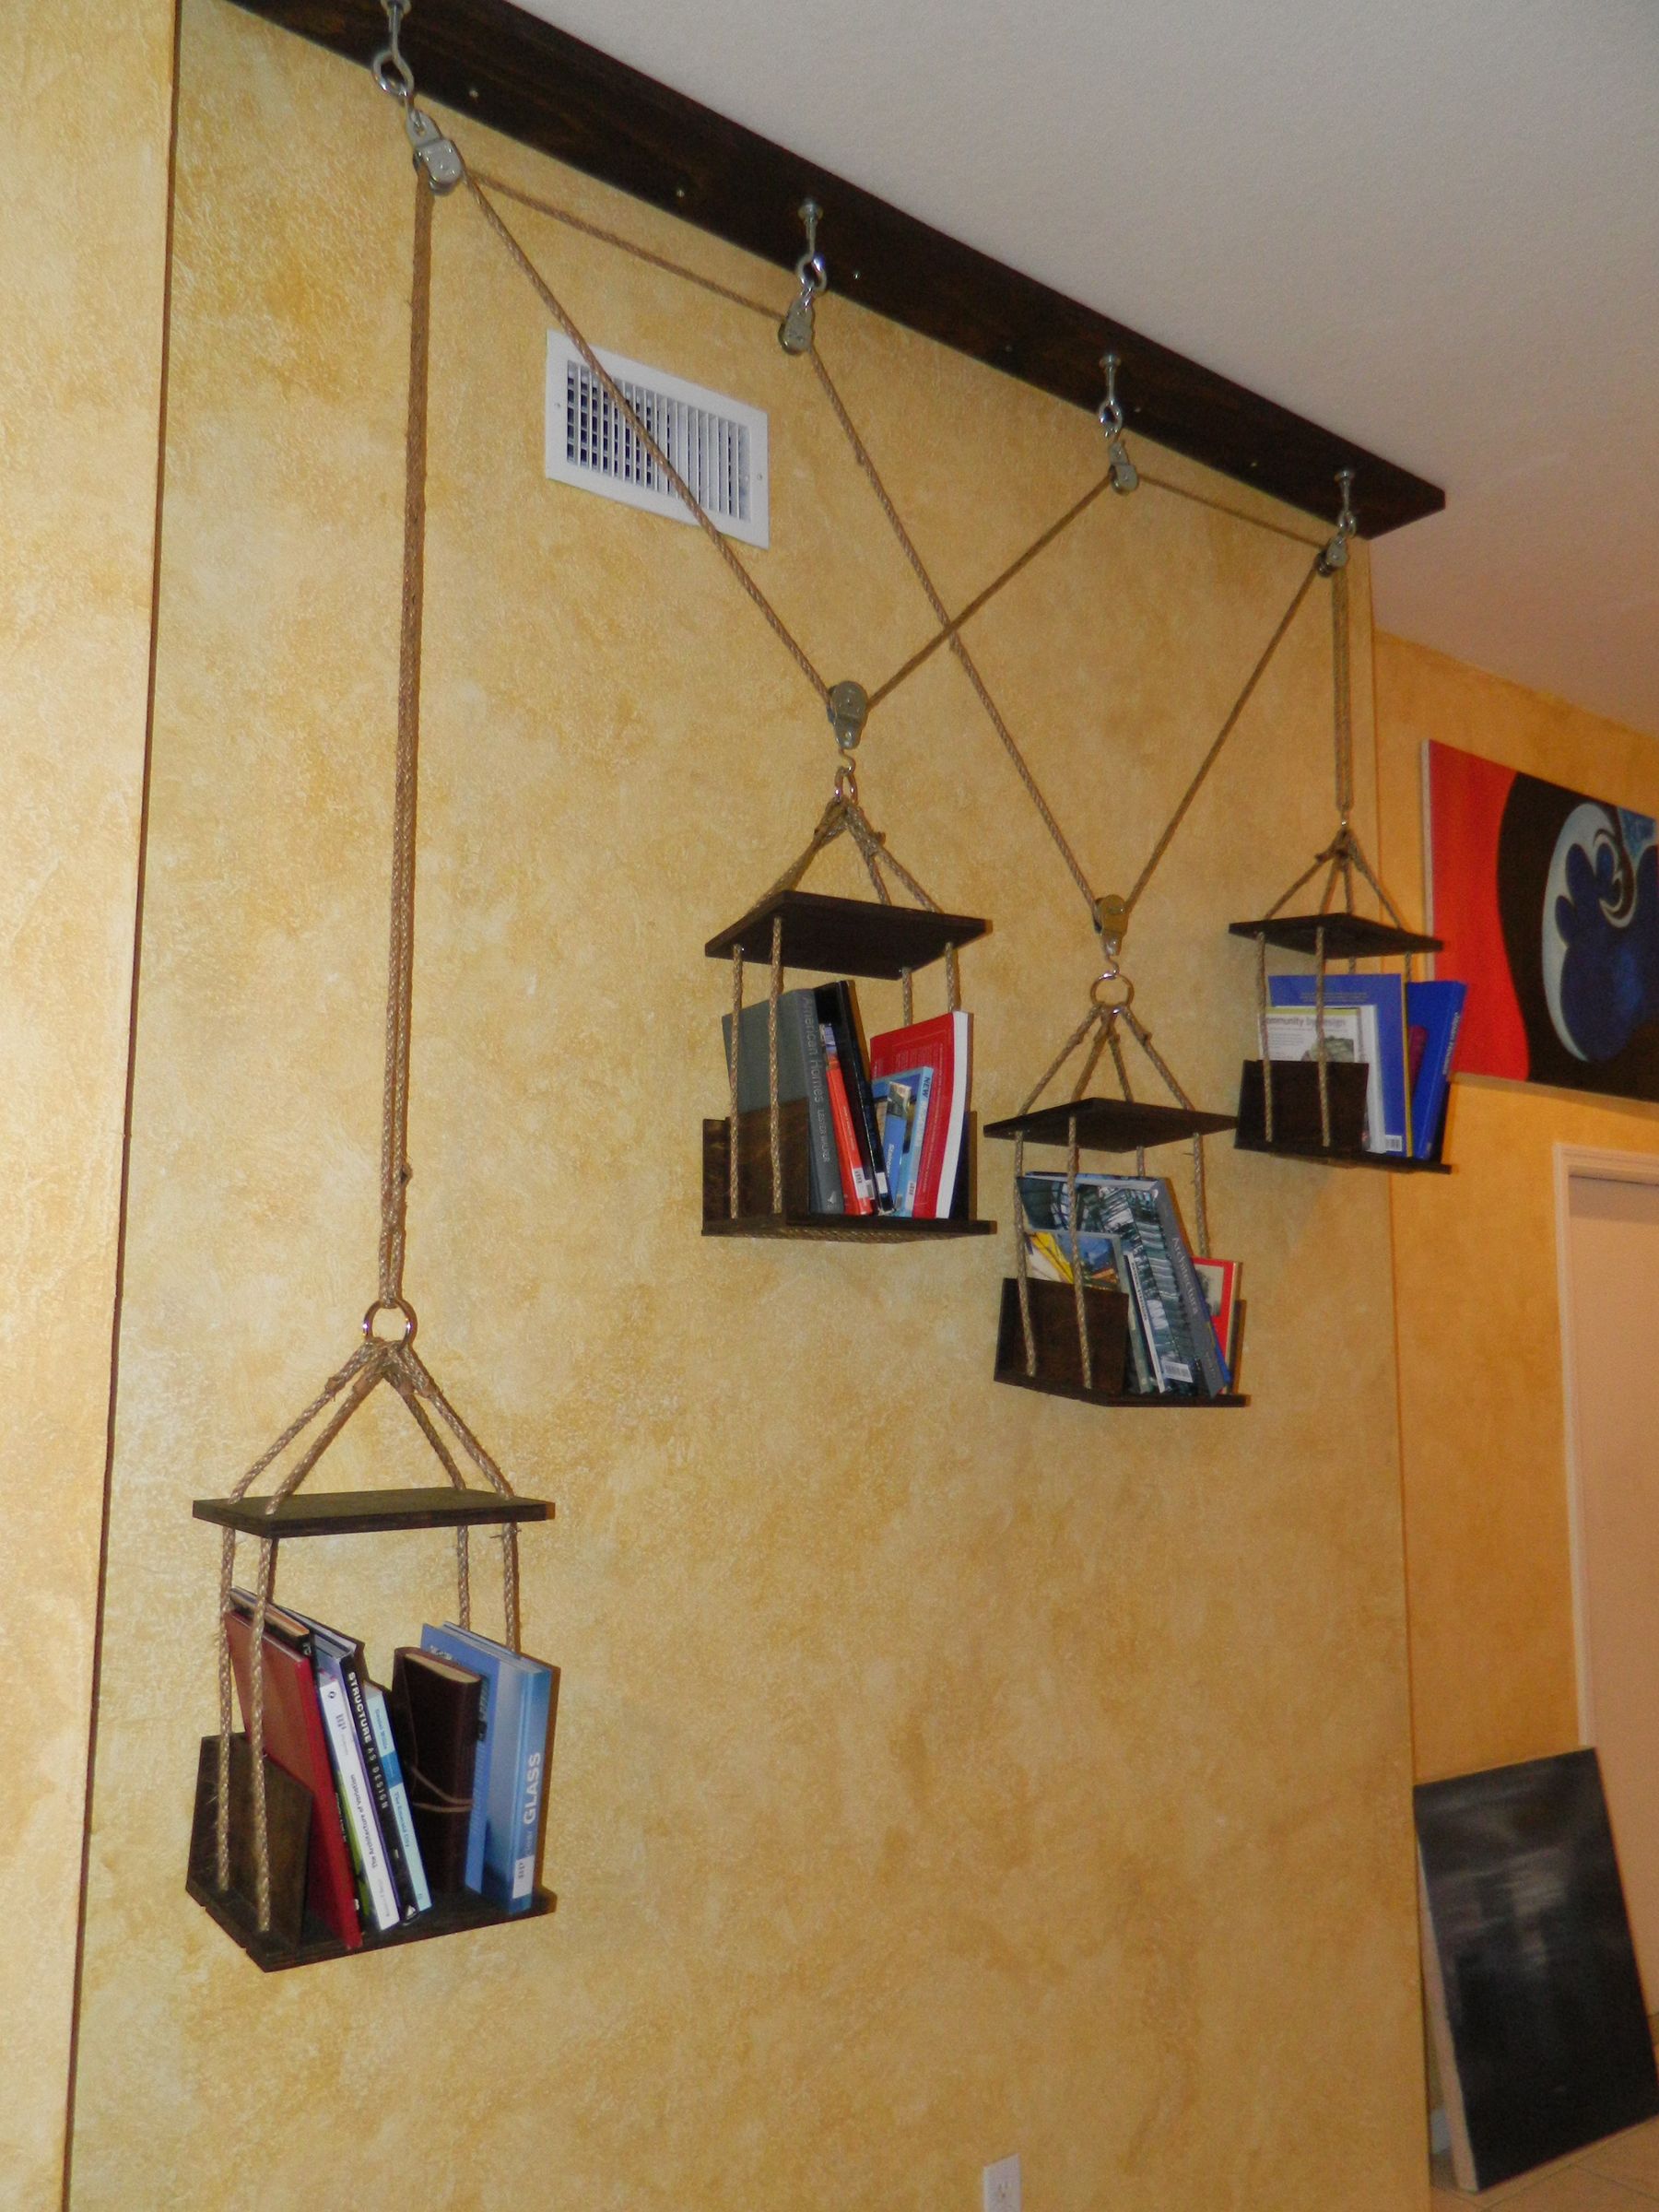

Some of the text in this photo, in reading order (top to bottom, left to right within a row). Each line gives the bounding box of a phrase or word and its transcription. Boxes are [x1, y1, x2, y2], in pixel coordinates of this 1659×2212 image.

[1265, 1017, 1304, 1027] ommunity
[803, 996, 824, 1103] American Homes
[922, 1077, 931, 1099] NEW
[887, 1143, 895, 1177] Stairca
[347, 1671, 389, 1808] STRUCTURE AS DESIGN
[350, 1773, 362, 1805] Variation
[524, 1752, 541, 1825] GLASS
[360, 1814, 375, 1854] Architecture
